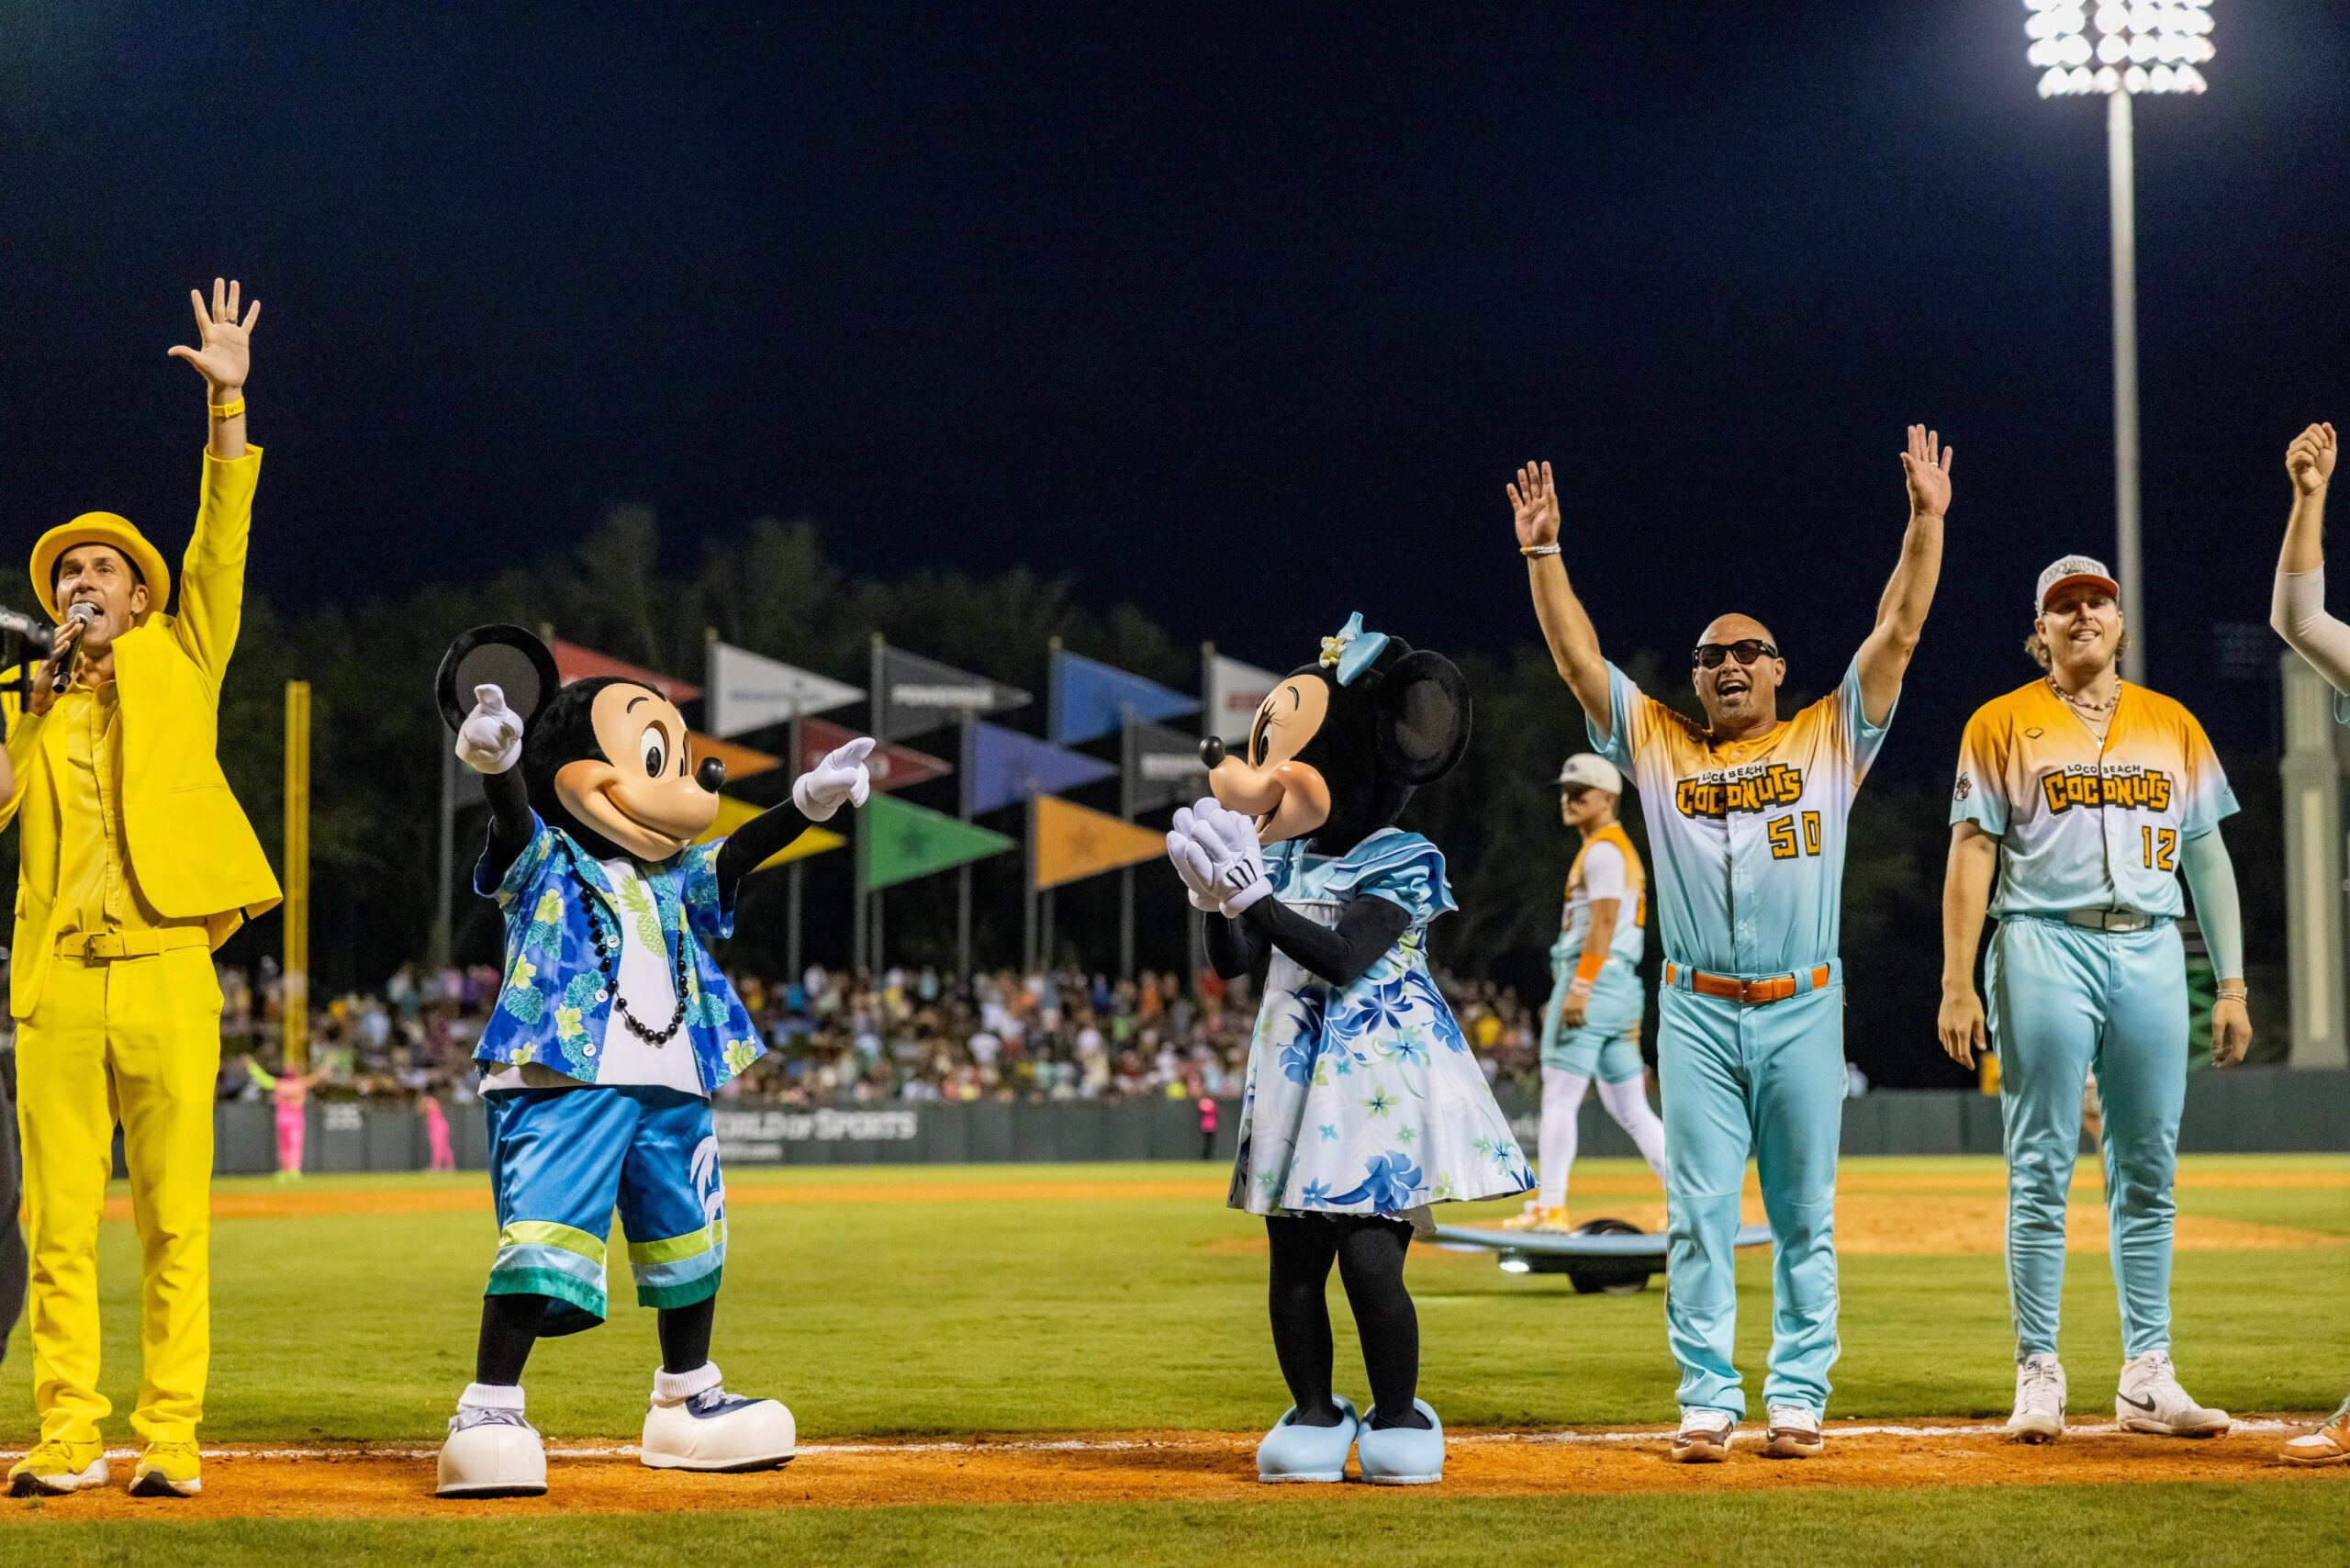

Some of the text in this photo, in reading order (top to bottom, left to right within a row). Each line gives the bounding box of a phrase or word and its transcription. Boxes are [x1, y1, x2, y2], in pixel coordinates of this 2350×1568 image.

[1676, 763, 1802, 819] COCONUTS
[1728, 765, 1762, 778] BEACH
[2042, 769, 2170, 814] COCONUTS
[2067, 764, 2141, 774] LOCO BEACH
[1766, 810, 1820, 860] 50
[2142, 824, 2177, 871] 12
[714, 1110, 785, 1140] ORLD
